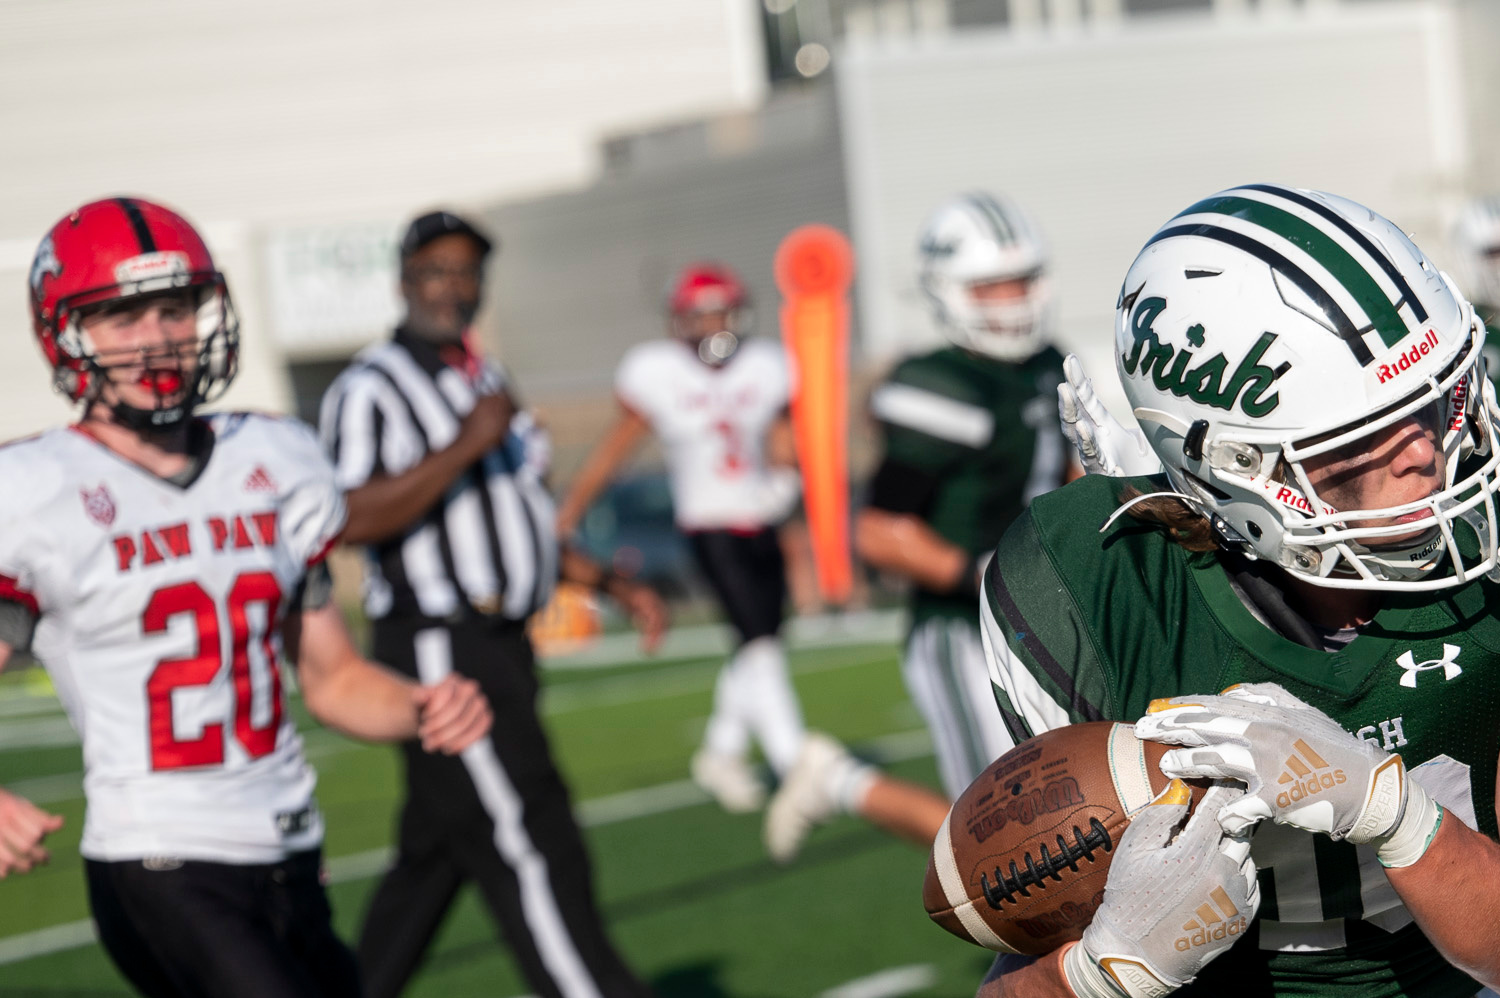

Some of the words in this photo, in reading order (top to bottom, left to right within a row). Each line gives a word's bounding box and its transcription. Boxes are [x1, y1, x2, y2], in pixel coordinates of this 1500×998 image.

[1122, 296, 1280, 419] Irish
[1375, 328, 1439, 385] Riddell
[112, 523, 192, 573] PAW
[207, 511, 279, 551] PAW
[1410, 534, 1443, 562] Riddell
[141, 571, 286, 773] 20
[969, 776, 1084, 844] Wilson
[1275, 768, 1347, 809] adidas
[1360, 773, 1396, 836] ADIZERO
[1174, 916, 1247, 952] adidas
